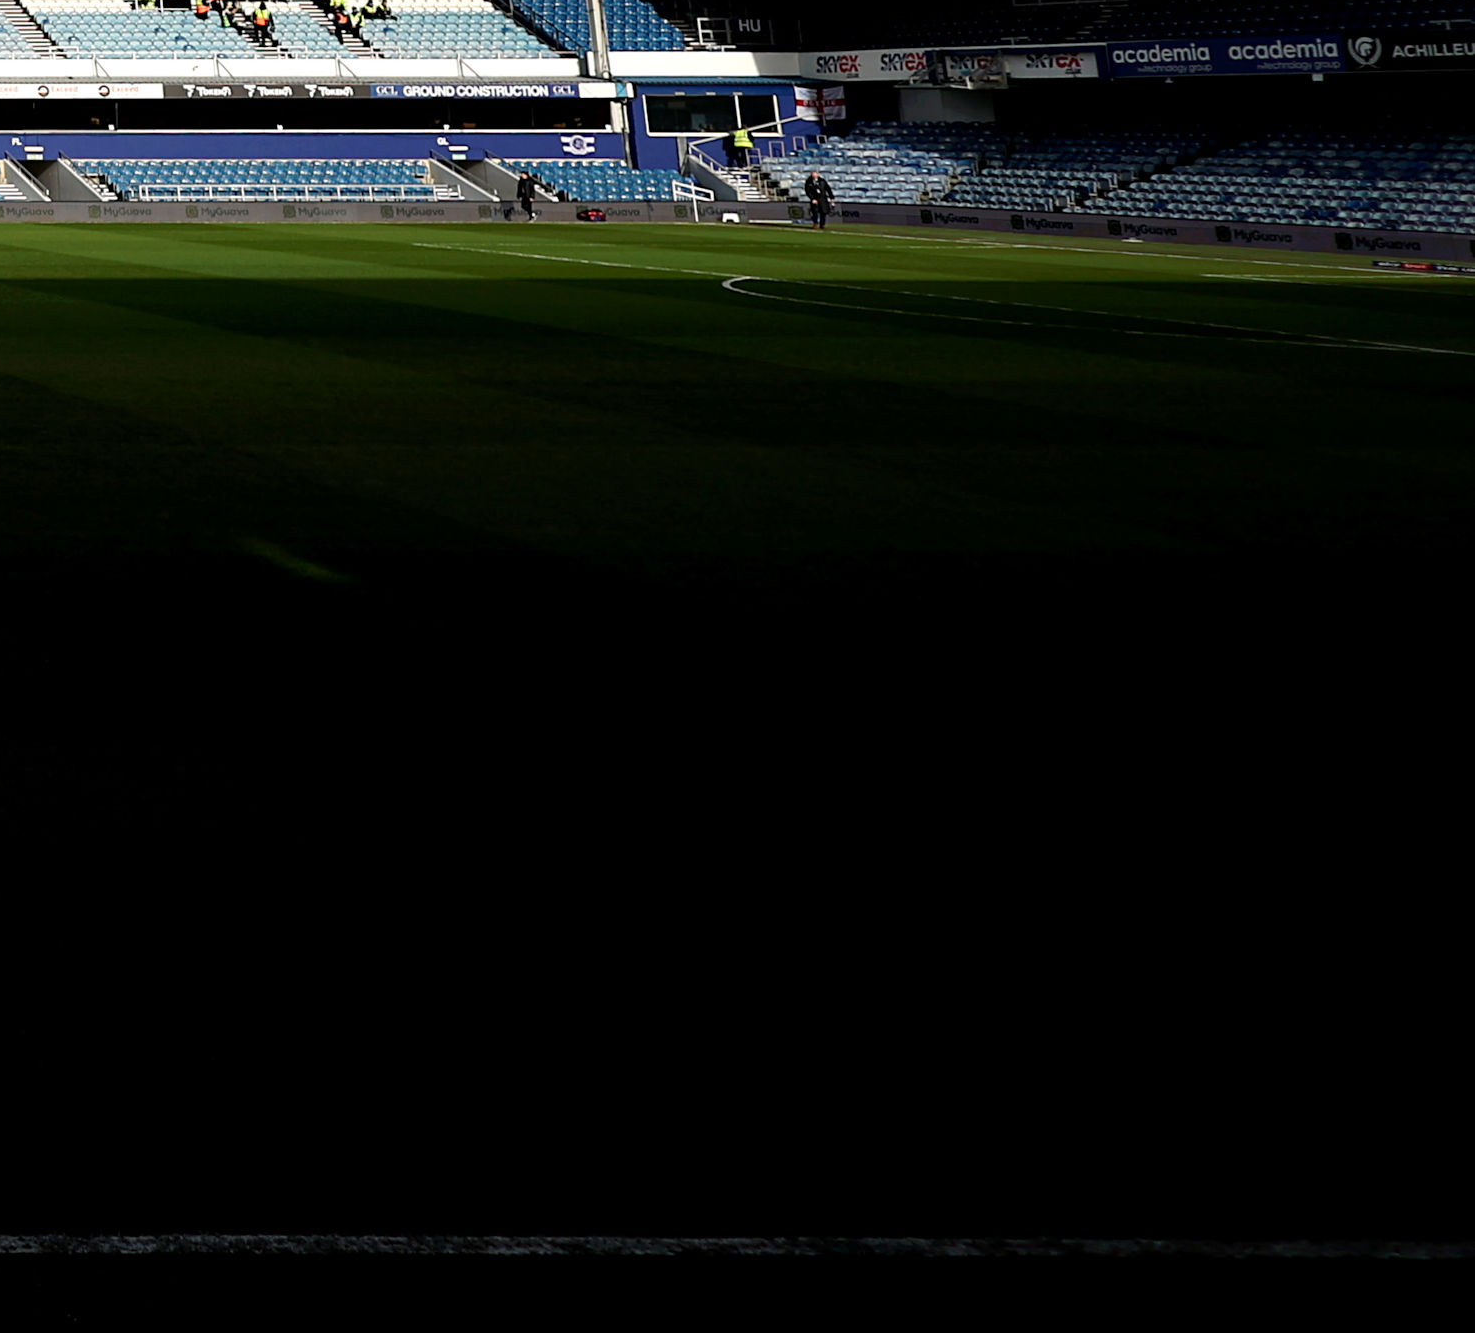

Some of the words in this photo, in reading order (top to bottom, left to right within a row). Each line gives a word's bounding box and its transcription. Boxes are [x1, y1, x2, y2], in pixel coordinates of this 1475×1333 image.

[738, 19, 762, 33] HU
[1112, 43, 1211, 63] academia
[1228, 38, 1339, 60] academia
[816, 55, 860, 74] SKYEX
[403, 85, 455, 97] GROUND
[456, 85, 549, 97] CONSTRUCTION
[6, 207, 54, 218] MyGuava
[104, 207, 152, 218] MyGuava
[201, 207, 249, 218] MyGuava
[298, 207, 346, 218] MyGuava
[396, 207, 445, 218] MyGuava
[934, 211, 979, 225] MyGuava
[1026, 217, 1074, 230] MyGuava
[1123, 223, 1177, 238] MyGuava
[1234, 229, 1292, 243] MyGuava
[1355, 236, 1421, 251] MyGuava
